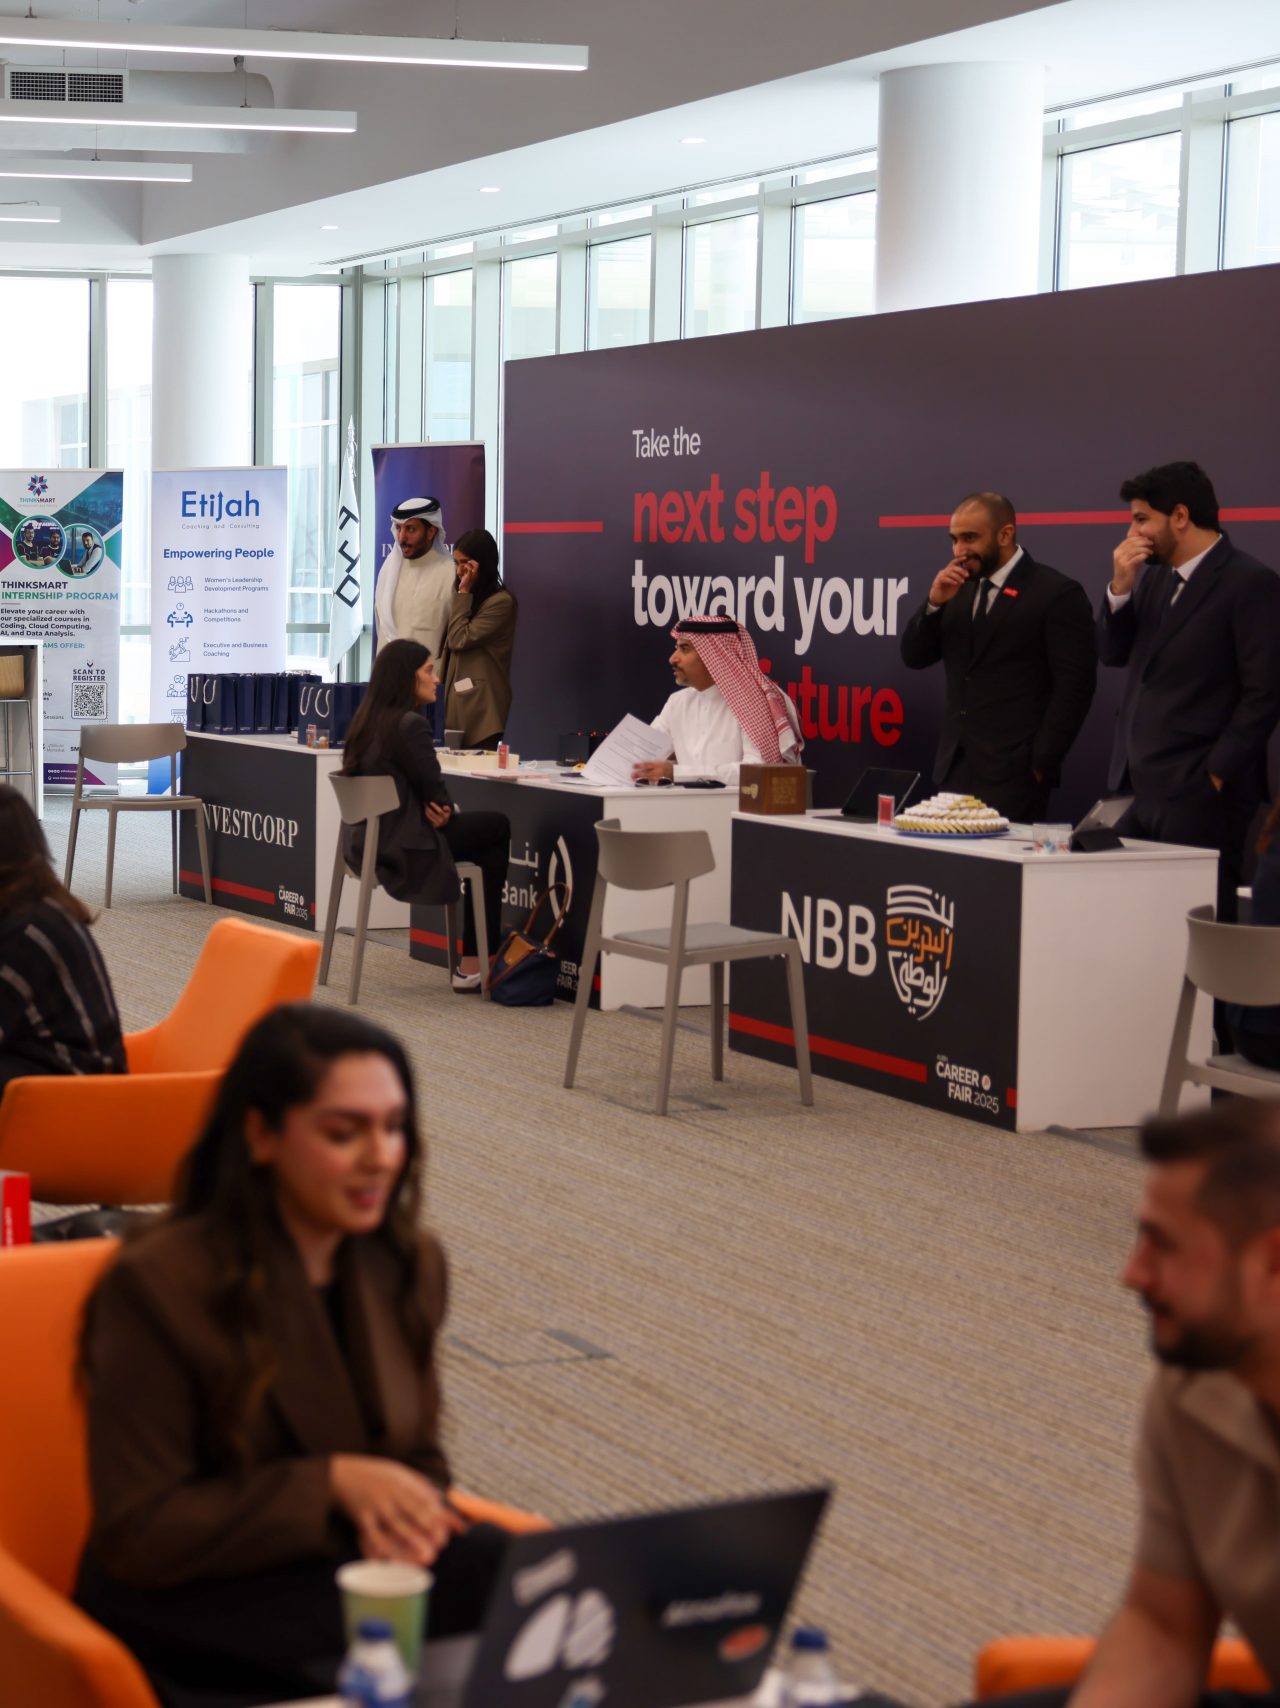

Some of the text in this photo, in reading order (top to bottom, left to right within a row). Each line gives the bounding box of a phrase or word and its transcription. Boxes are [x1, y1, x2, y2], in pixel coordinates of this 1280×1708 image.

[632, 426, 701, 458] Take the
[633, 471, 838, 564] next step
[163, 547, 274, 560] Empowering People
[1, 581, 68, 589] THINKSMART
[1, 592, 119, 600] INTERNSHIP PROGRAM
[632, 555, 909, 656] toward your
[759, 658, 904, 747] ture
[202, 803, 298, 848] NVESTCORP
[781, 891, 877, 977] NBB
[935, 1061, 980, 1088] CAREER
[948, 1081, 1000, 1115] FAIR 2025
